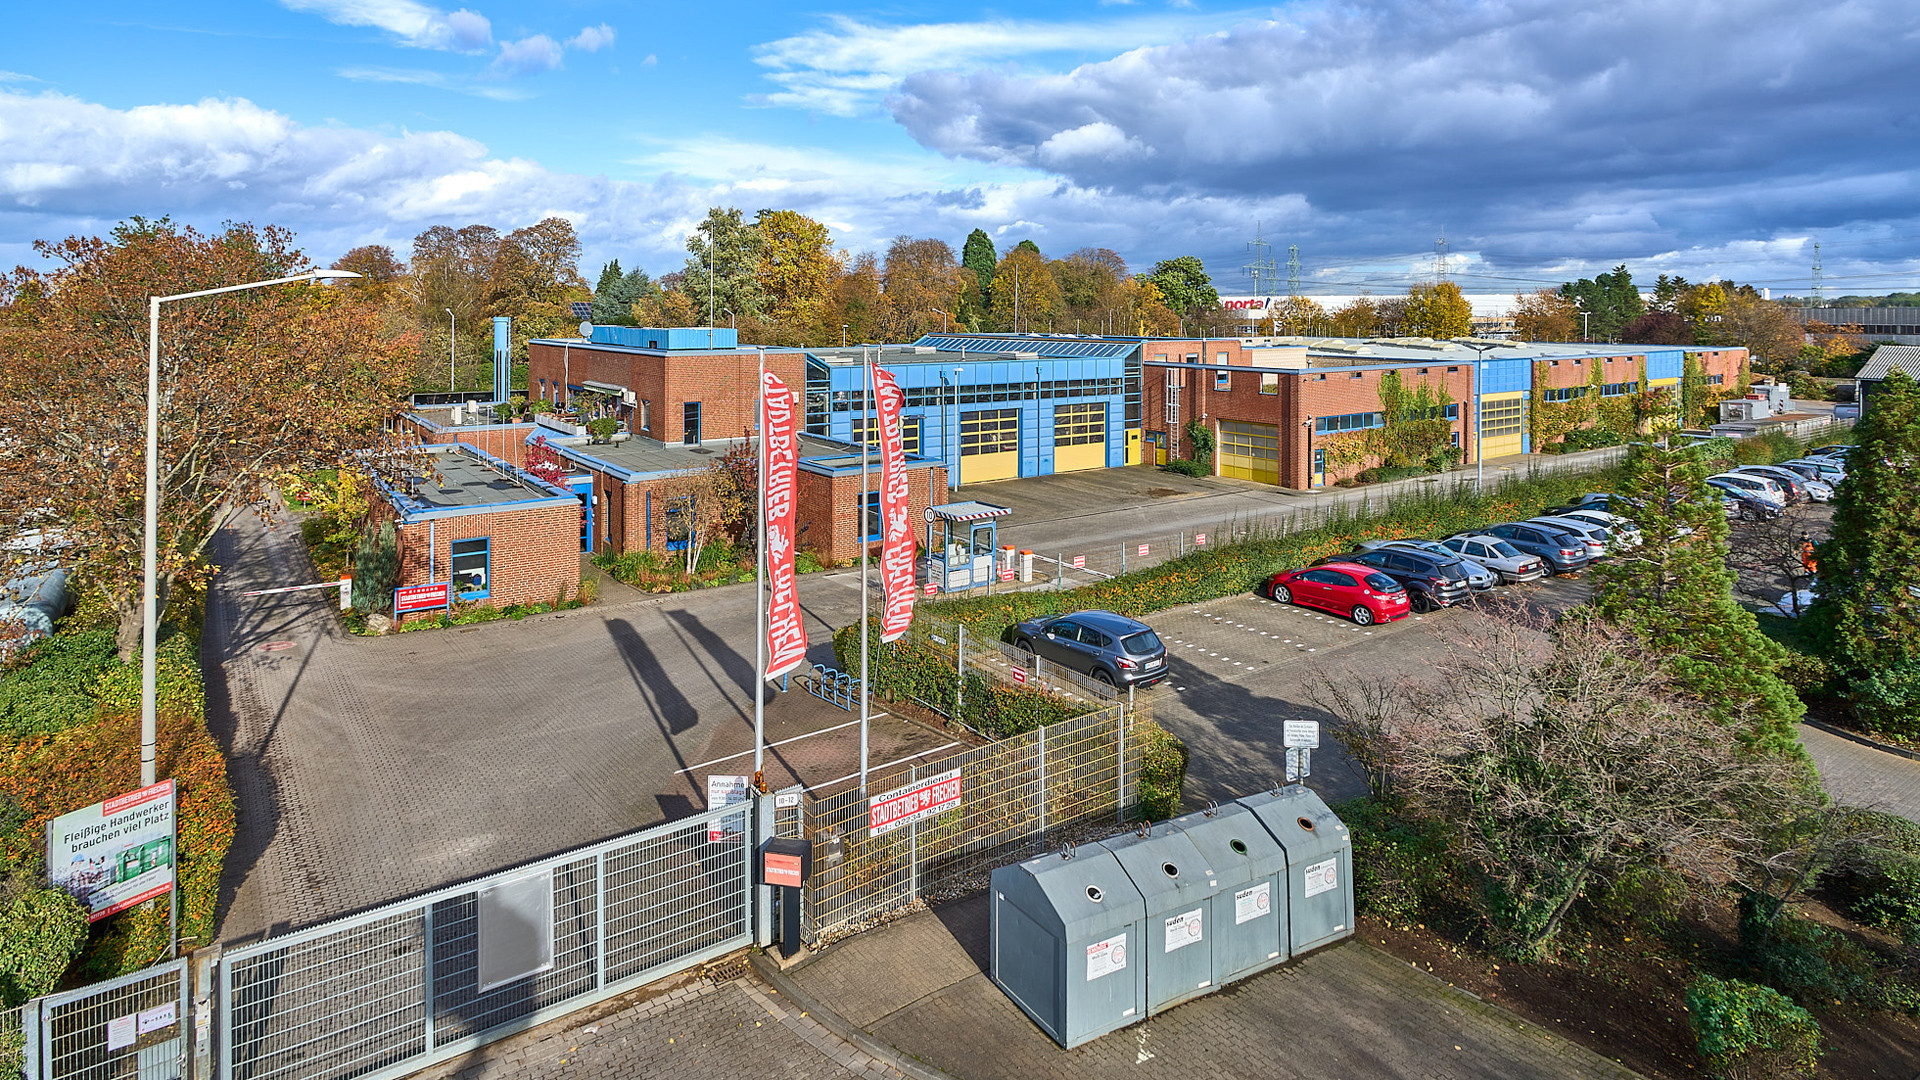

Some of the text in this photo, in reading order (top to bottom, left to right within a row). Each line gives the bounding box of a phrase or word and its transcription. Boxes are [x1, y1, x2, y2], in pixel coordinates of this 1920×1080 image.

[926, 511, 933, 520] 10
[711, 780, 745, 788] Annahme
[878, 772, 953, 803] Containerdienst
[778, 796, 794, 805] 10-12
[871, 778, 960, 827] STADTBETRIEB FRECHEN
[64, 823, 107, 844] Fleißige
[110, 800, 170, 827] Handwerker
[71, 811, 170, 854] brauchen viel Platz
